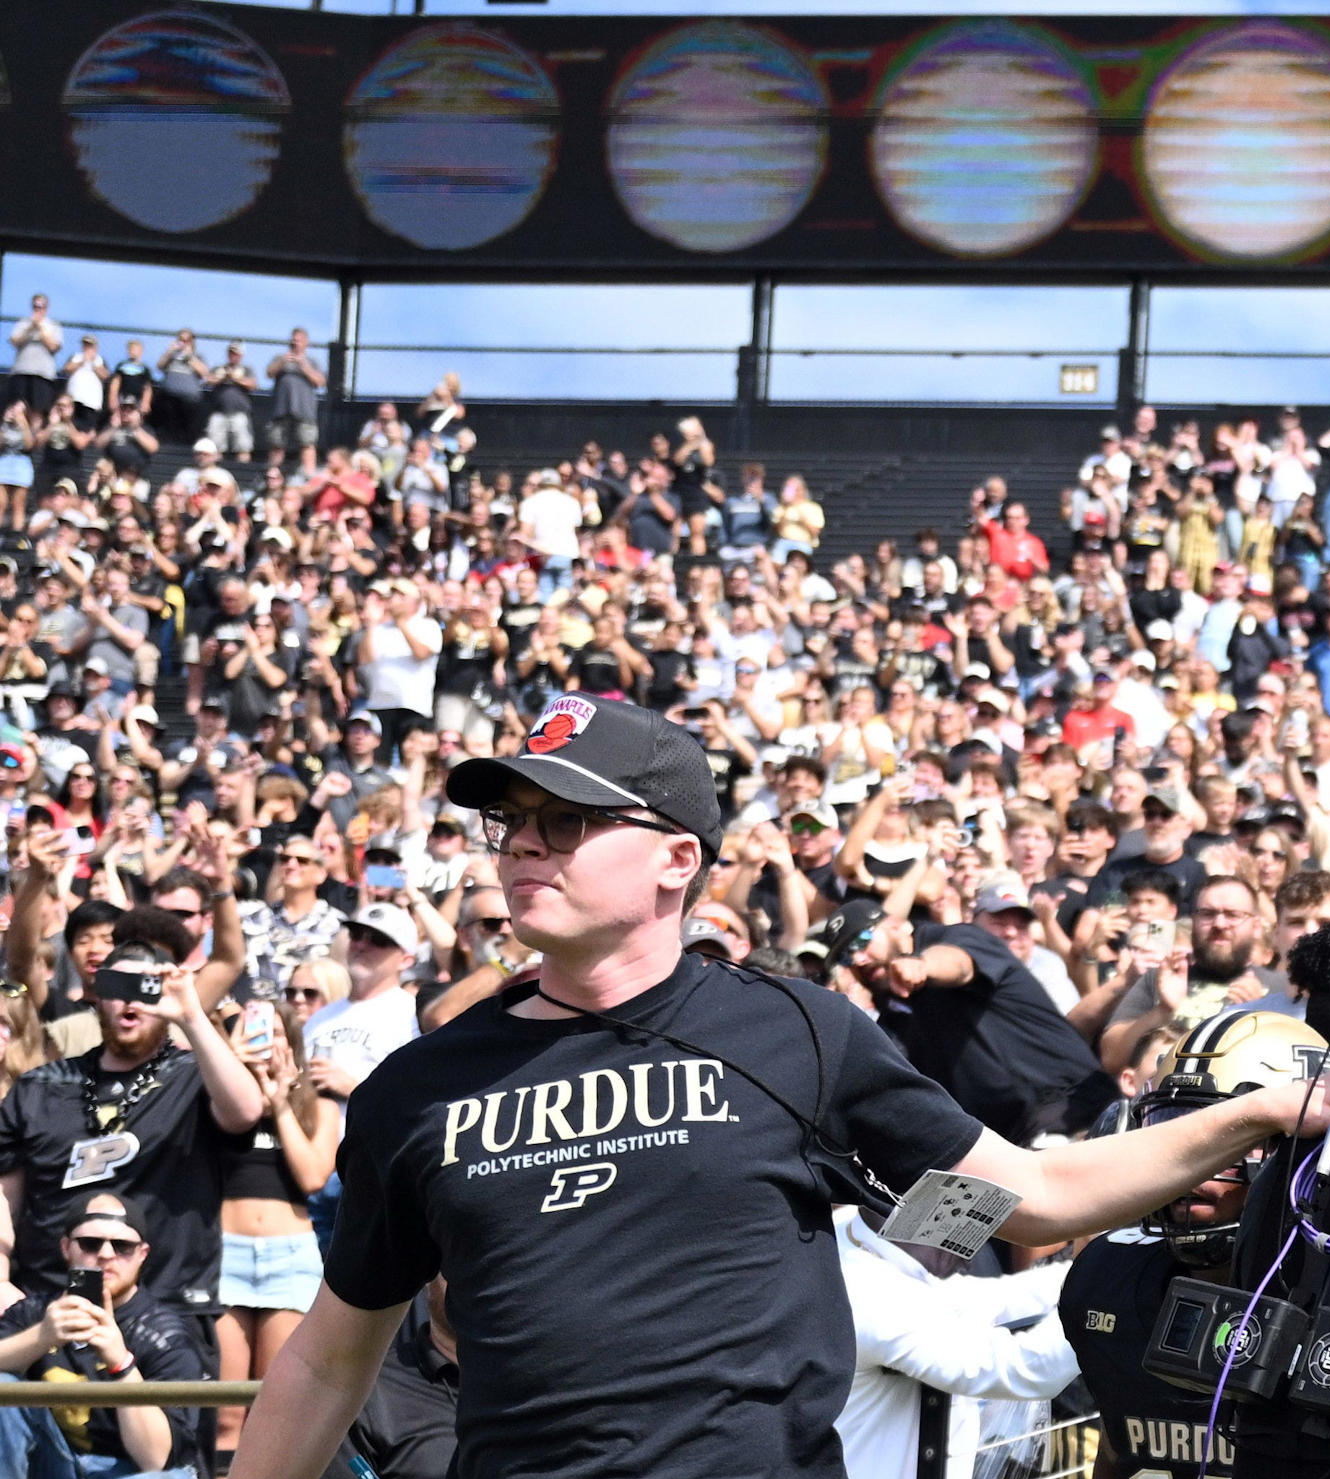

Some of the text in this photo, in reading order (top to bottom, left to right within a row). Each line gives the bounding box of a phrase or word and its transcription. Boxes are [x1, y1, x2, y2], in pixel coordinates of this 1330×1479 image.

[440, 1058, 729, 1167] PURDUE
[61, 1131, 141, 1189] P
[467, 1129, 689, 1180] POLYTECHNIC INSTITUTE
[540, 1161, 617, 1213] P
[1125, 1416, 1236, 1466] PURDU
